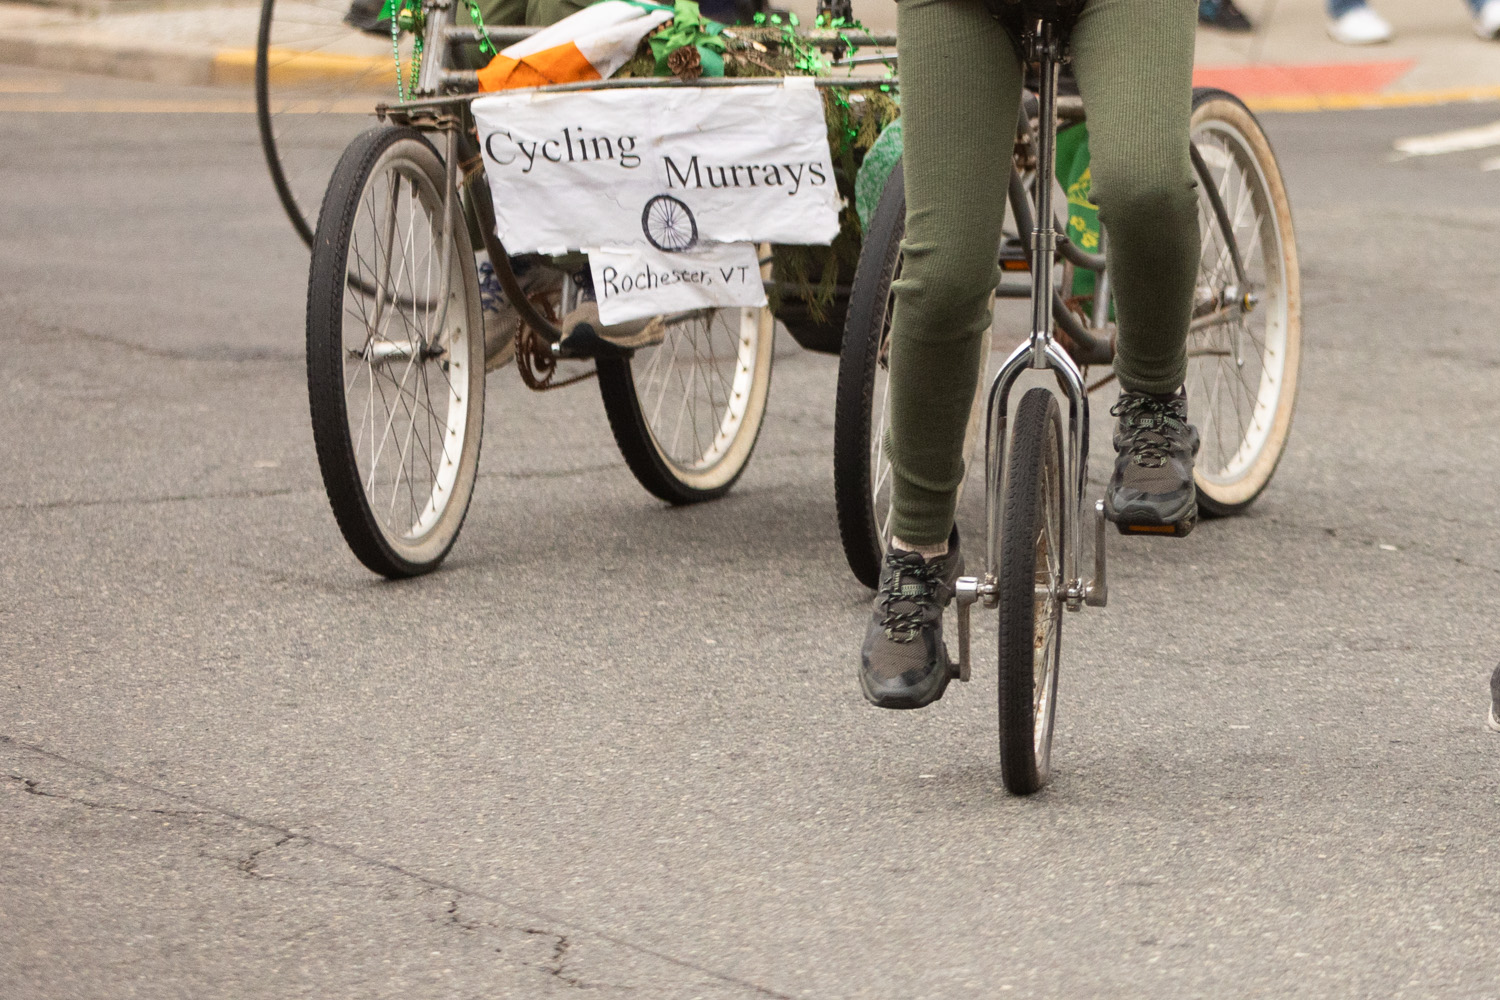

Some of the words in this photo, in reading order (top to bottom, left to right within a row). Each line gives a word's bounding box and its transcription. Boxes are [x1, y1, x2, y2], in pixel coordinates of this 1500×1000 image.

[484, 127, 642, 173] Cycling
[663, 154, 827, 195] Murrays
[601, 264, 712, 299] Rochester,
[719, 265, 749, 284] VT
